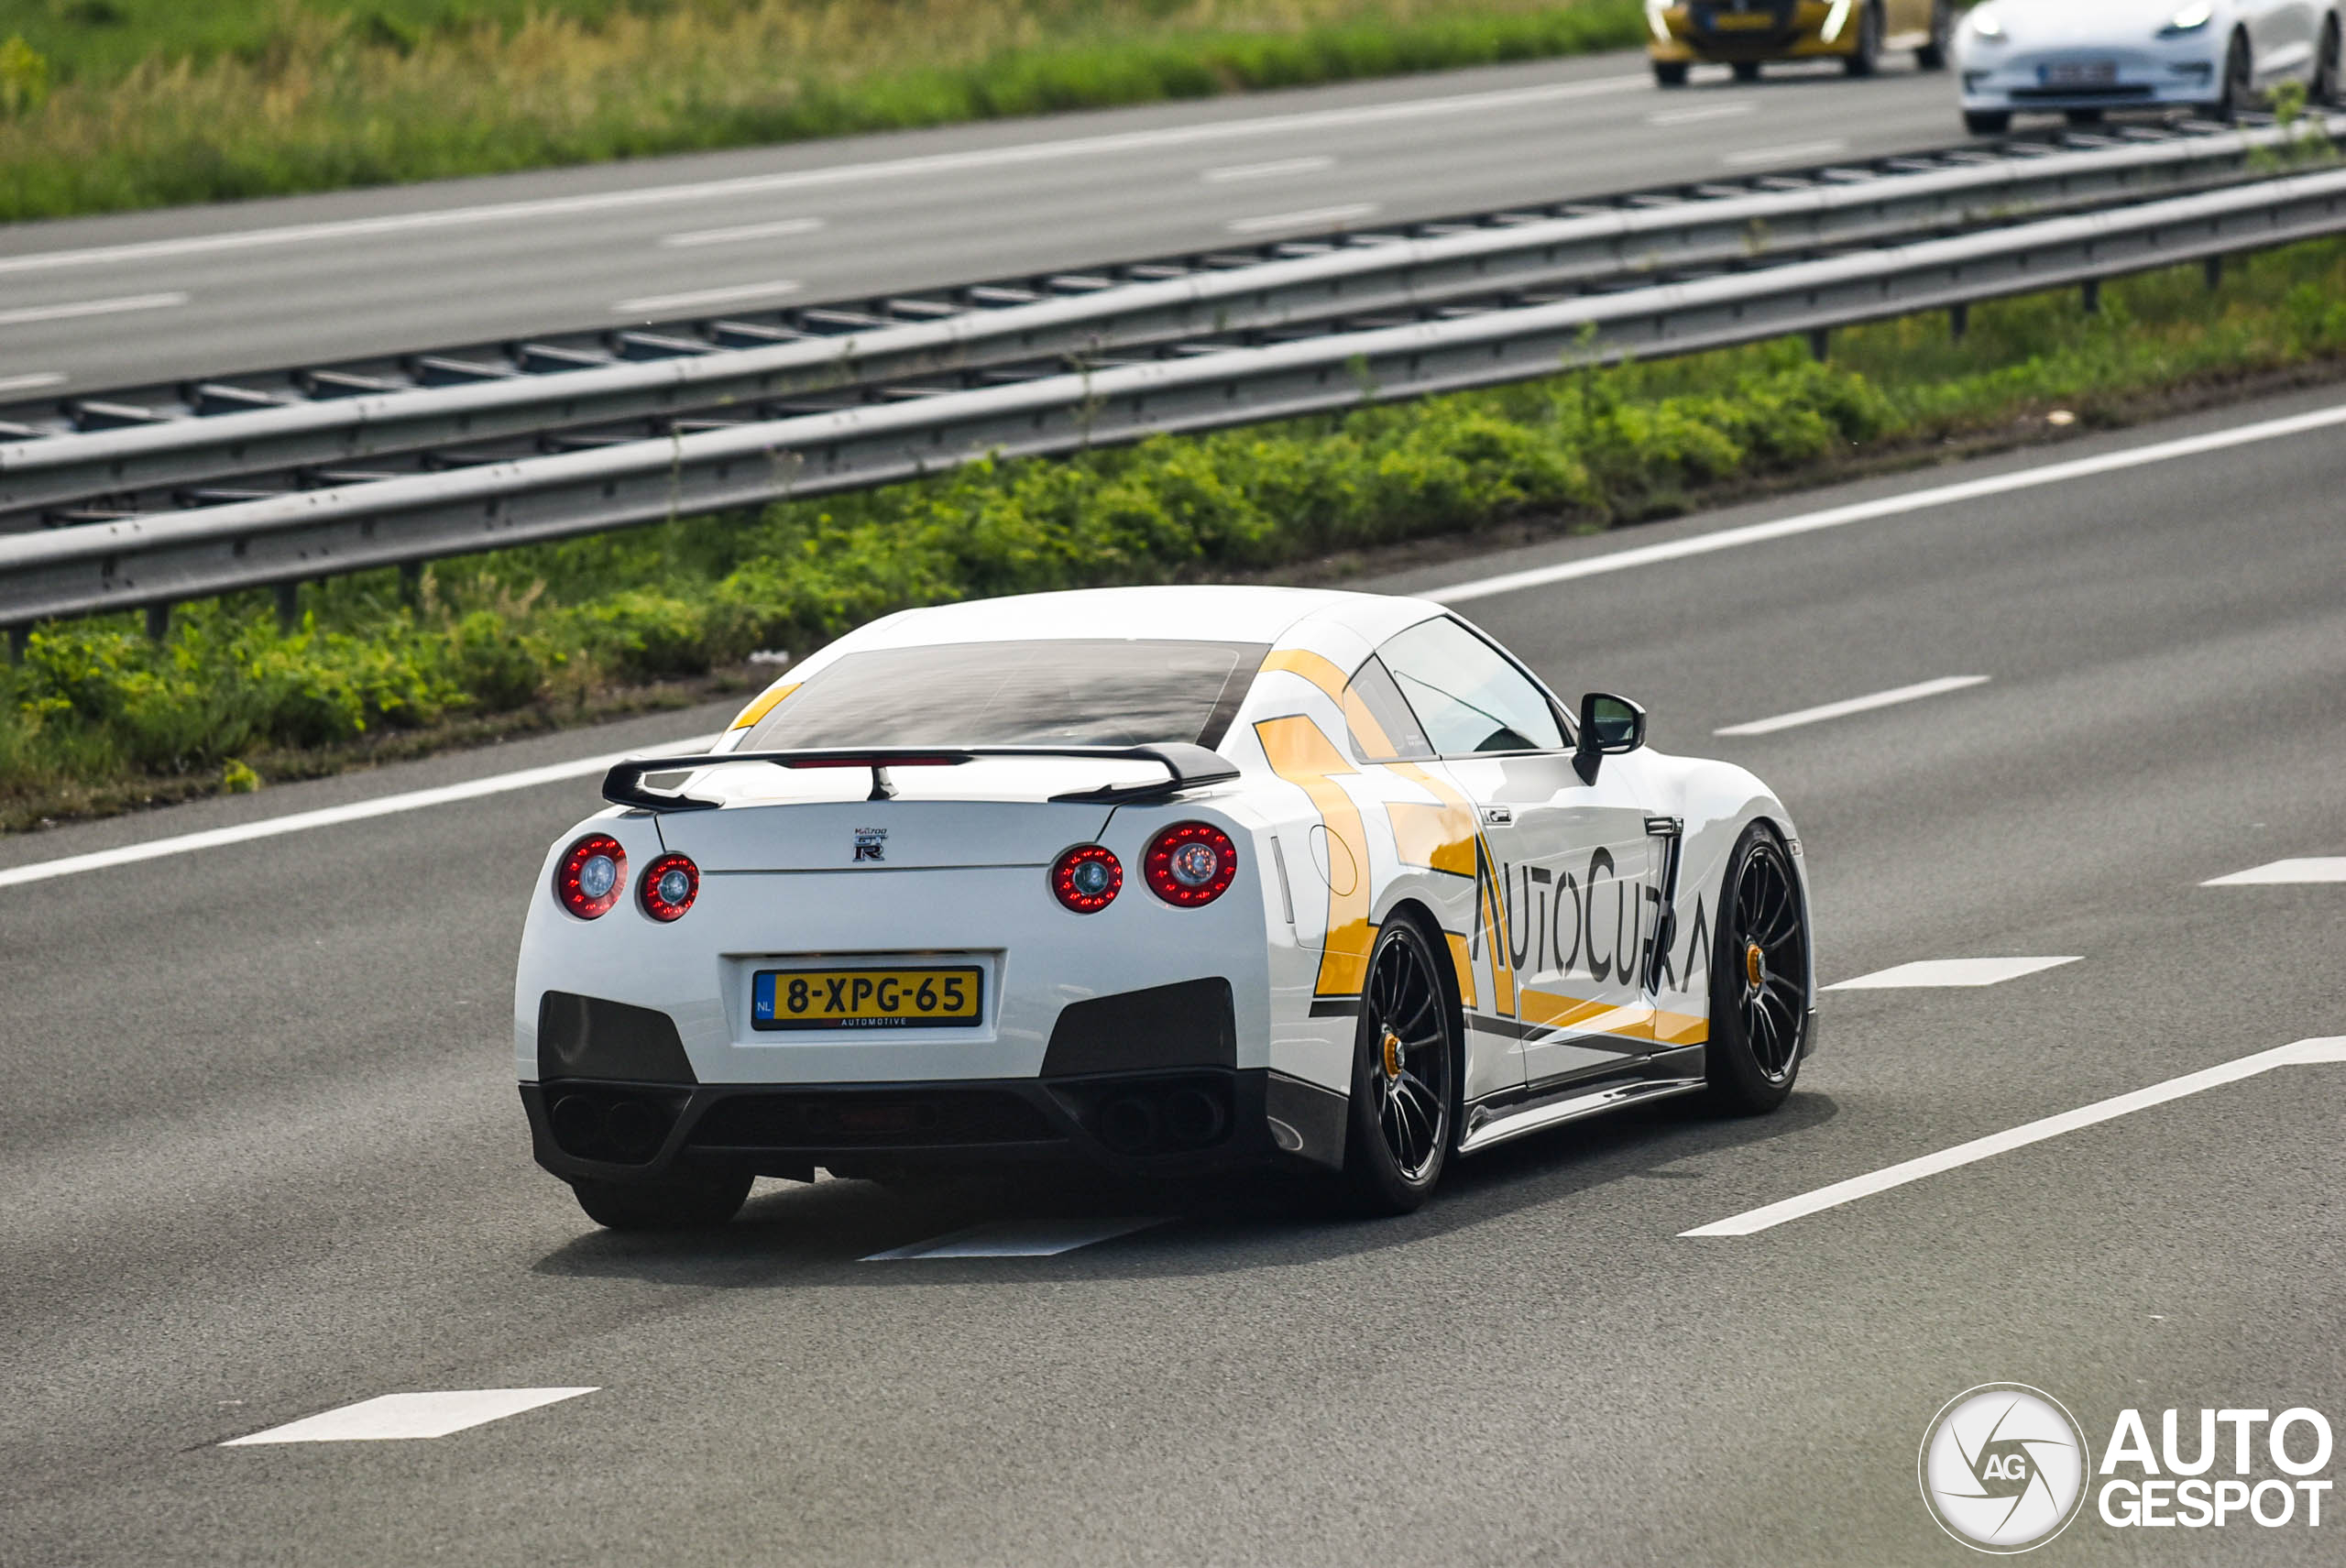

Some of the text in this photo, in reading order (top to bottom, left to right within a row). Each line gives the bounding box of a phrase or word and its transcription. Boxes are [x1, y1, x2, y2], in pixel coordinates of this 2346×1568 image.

[786, 977, 965, 1014] 8-XPG-65
[757, 1002, 772, 1013] NL
[841, 1017, 906, 1026] AUTOMOTIVE
